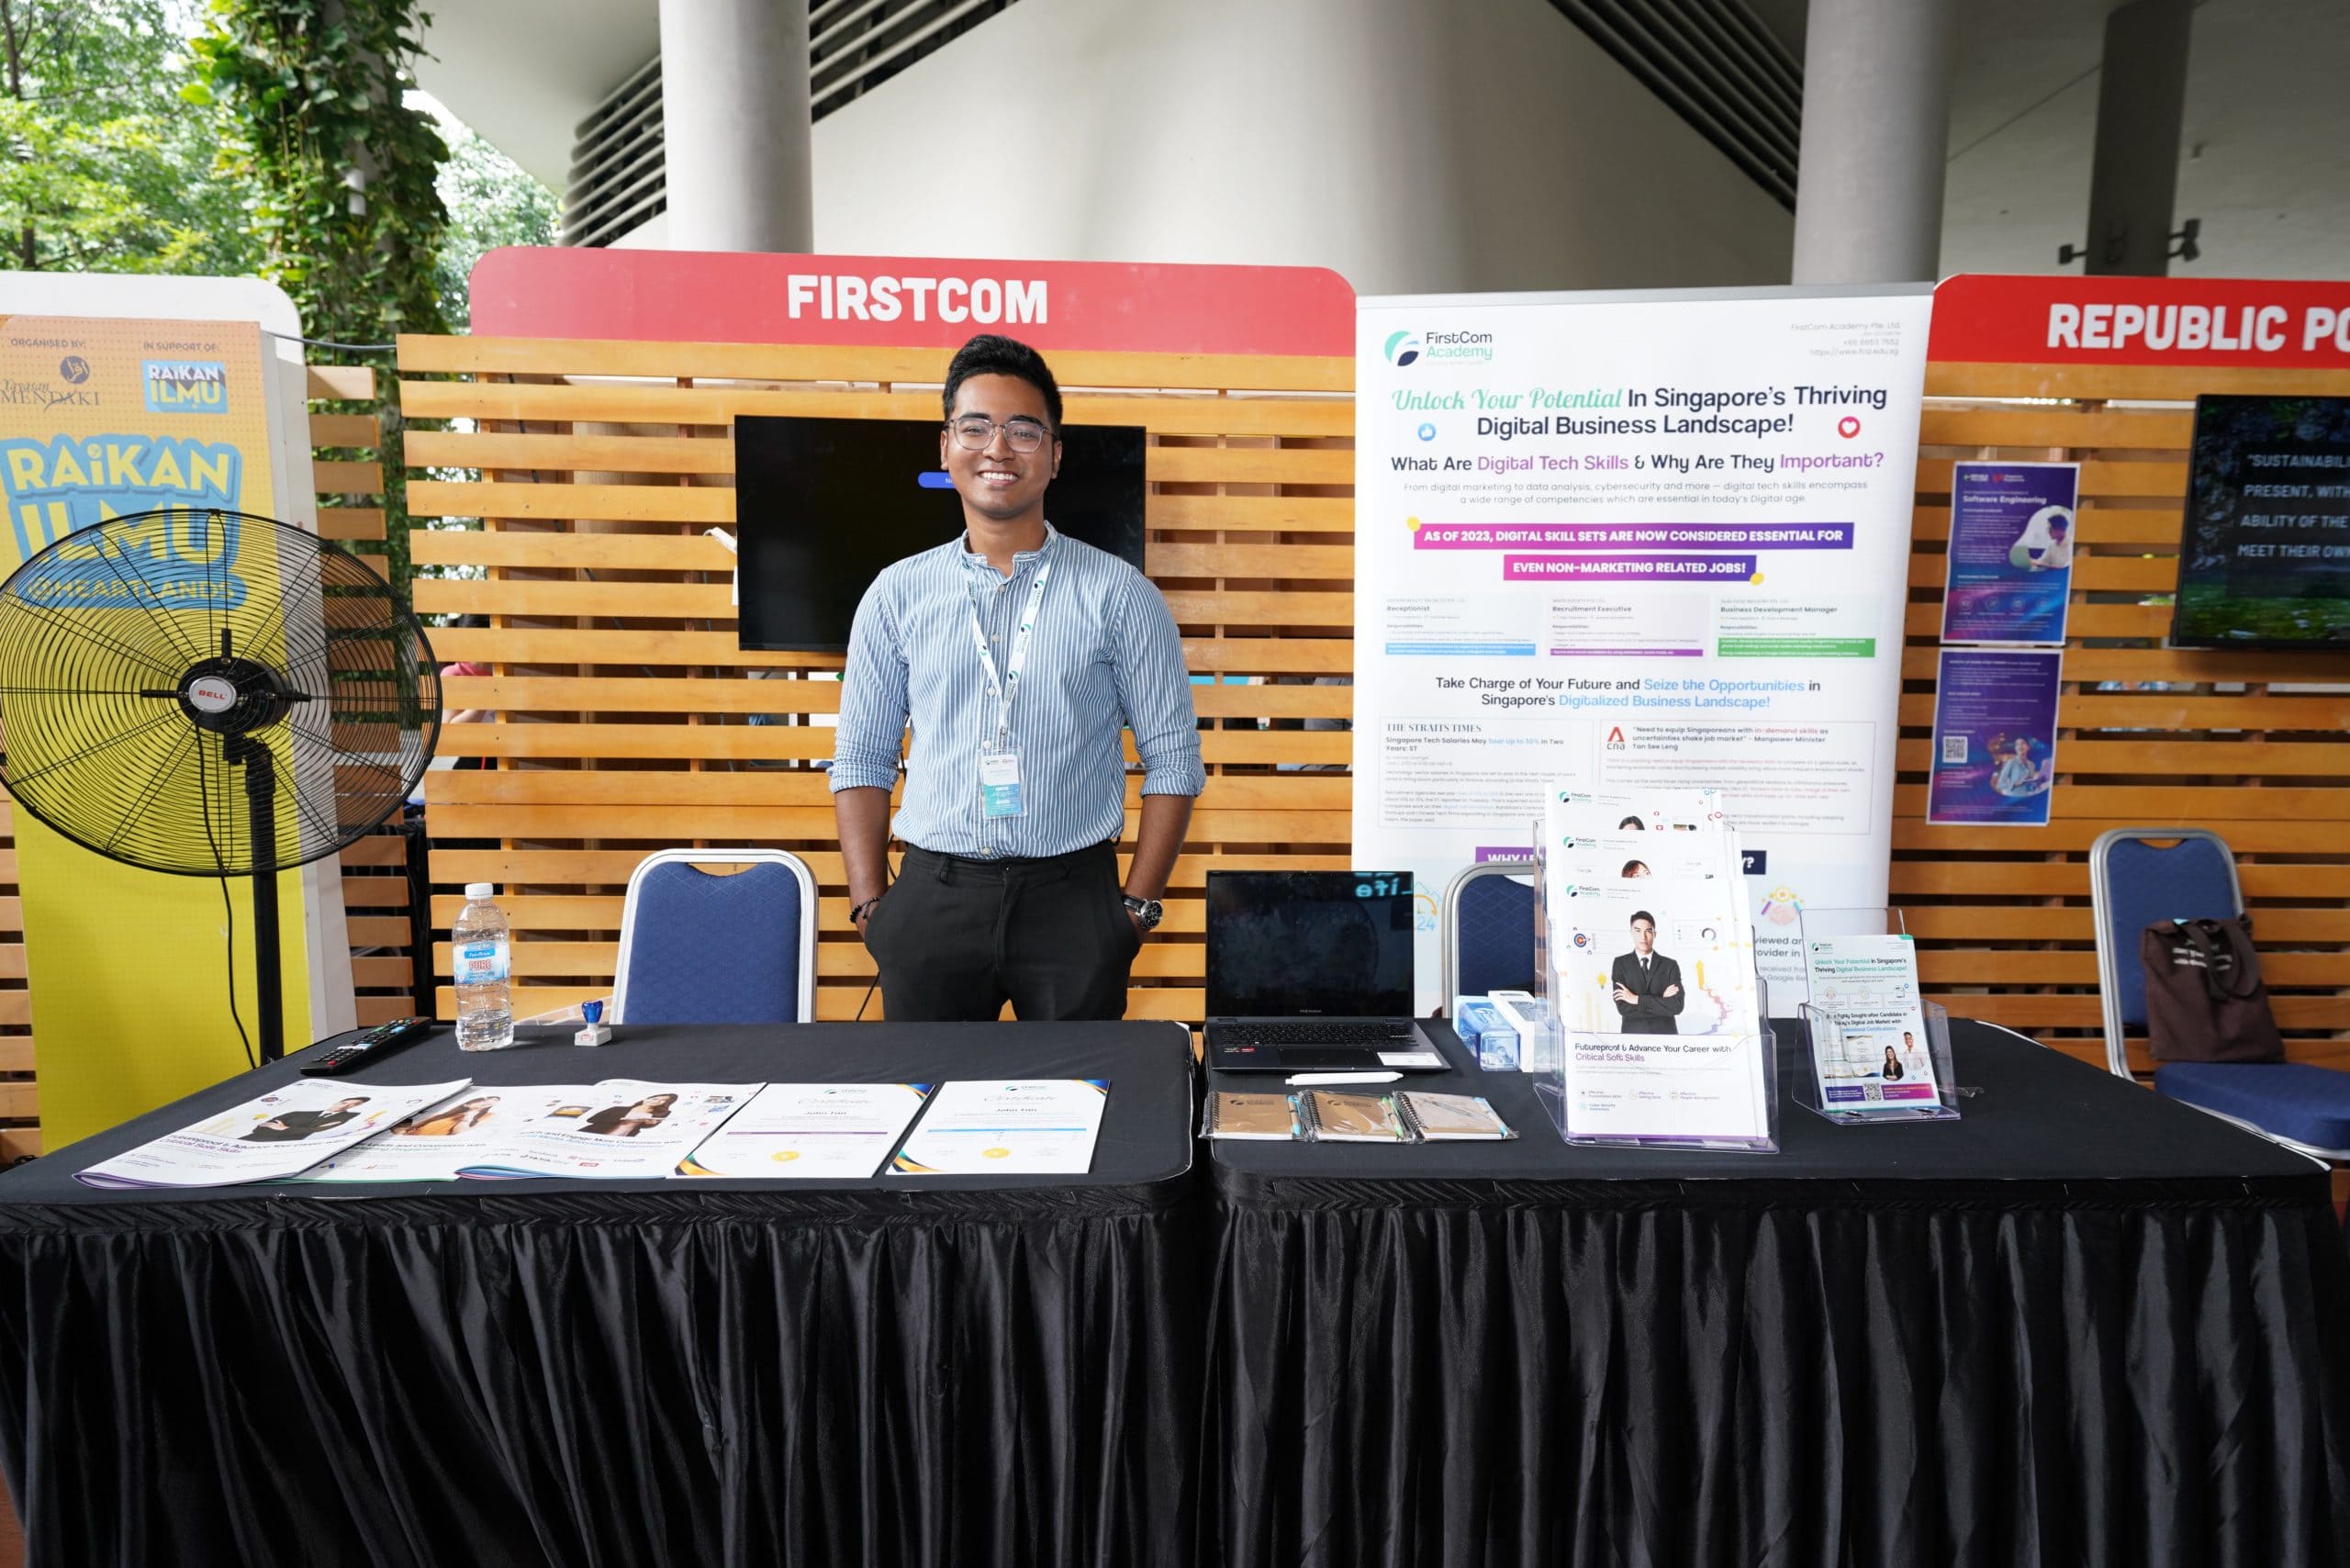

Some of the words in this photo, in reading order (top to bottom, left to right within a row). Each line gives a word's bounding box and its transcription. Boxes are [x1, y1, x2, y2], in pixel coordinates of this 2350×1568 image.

[788, 274, 1047, 324] FIRSTCOM
[1829, 323, 1867, 331] Academy
[2047, 303, 2288, 352] REPUBLIC
[11, 338, 68, 348] ORGANISED
[1426, 330, 1493, 343] FirstCom
[144, 342, 153, 351] IN
[156, 342, 201, 352] SUPPORT
[1426, 345, 1493, 360] Academy
[1, 378, 50, 393] Yayasan
[150, 380, 221, 404] ILMU
[0, 390, 100, 410] MENDAKI
[1392, 389, 1464, 410] Unlock
[1471, 388, 1523, 409] Your
[1528, 389, 1621, 409] Potential
[1628, 388, 1647, 407] In
[1654, 386, 1785, 411] Singapore's
[1794, 385, 1886, 409] Thriving
[1477, 416, 1549, 441] Digital
[1555, 415, 1656, 435] Business
[1663, 413, 1793, 439] Landscape!
[1391, 456, 1438, 471] What
[1443, 456, 1472, 470] Are
[1478, 455, 1533, 475] Digital
[1539, 455, 1579, 470] Tech
[1583, 454, 1628, 470] Skills
[1634, 454, 1645, 469] &
[1651, 454, 1689, 474] Why
[1695, 454, 1724, 469] Are
[1730, 454, 1774, 474] They
[1780, 452, 1884, 473] Important?
[1403, 483, 1428, 491] From
[1429, 483, 1460, 494] digital
[1461, 483, 1512, 493] marketing
[1525, 483, 1550, 491] data
[1550, 483, 1593, 492] analysis,
[1594, 482, 1662, 492] cybersecurity
[1662, 481, 1684, 490] and
[1684, 482, 1711, 490] more
[1722, 481, 1755, 493] digital
[1756, 481, 1780, 490] tech
[1781, 480, 1807, 489] skills
[1807, 481, 1868, 490] encompass
[2244, 484, 2313, 498] PRESENT,
[1468, 496, 1492, 504] wide
[1493, 496, 1523, 506] range
[1525, 495, 1534, 503] of
[1535, 496, 1605, 505] competencies
[1606, 494, 1636, 503] which
[1637, 495, 1654, 503] are
[1655, 494, 1699, 503] essential
[1711, 495, 1749, 504] today's
[1750, 494, 1784, 505] Digital
[1785, 497, 1806, 505] age.
[1963, 495, 1998, 504] Software
[2000, 496, 2047, 506] Engineering
[2241, 514, 2297, 528] ABILITY
[2299, 515, 2318, 528] OF
[2321, 515, 2349, 529] THE
[1423, 531, 1441, 541] AS
[1441, 531, 1460, 542] OF
[1460, 530, 1494, 543] 2023,
[1494, 531, 1542, 541] DIGITAL
[1544, 531, 1575, 542] SKILL
[1577, 531, 1607, 542] SETS
[1608, 531, 1634, 541] ARE
[1635, 530, 1667, 541] NOW
[1669, 531, 1747, 541] CONSIDERED
[1749, 530, 1816, 541] ESSENTIAL
[1817, 530, 1843, 541] FOR
[2237, 543, 2277, 558] MEET
[2279, 544, 2322, 558] THEIR
[1513, 562, 1544, 572] EVEN
[1546, 562, 1654, 573] NON-MARKETING
[1655, 562, 1707, 573] RELATED
[1708, 562, 1746, 573] JOBS!
[1753, 606, 1803, 614] Development
[1804, 606, 1838, 614] Manager
[1436, 677, 1465, 688] Take
[1469, 677, 1515, 692] Charge
[1518, 678, 1531, 689] of
[1535, 678, 1563, 689] Your
[1567, 678, 1612, 689] Future
[1616, 678, 1639, 689] and
[1644, 678, 1678, 690] Seize
[1682, 679, 1705, 690] the
[1708, 678, 1805, 693] Opportunities
[1808, 679, 1820, 690] in
[1482, 693, 1555, 709] Singapore's
[1559, 694, 1628, 710] Digitalized
[1632, 695, 1691, 707] Business
[1695, 695, 1770, 711] Landscape!
[1387, 723, 1406, 732] THE
[1408, 723, 1449, 732] STRAITS
[1452, 723, 1482, 732] TIMES
[1685, 726, 1736, 734] Singaporeans
[1385, 736, 1423, 745] Singapore
[1470, 737, 1487, 745] May
[1607, 743, 1626, 751] cna
[469, 959, 493, 971] PURE
[1814, 966, 1836, 974] Thriving
[1574, 1043, 1620, 1052] Futureproof
[1628, 1044, 1662, 1052] Advance
[1663, 1044, 1681, 1053] Your
[1683, 1044, 1709, 1053] Career
[1712, 1045, 1731, 1053] with
[1575, 1053, 1605, 1061] Critical
[1625, 1054, 1645, 1062] Skills
